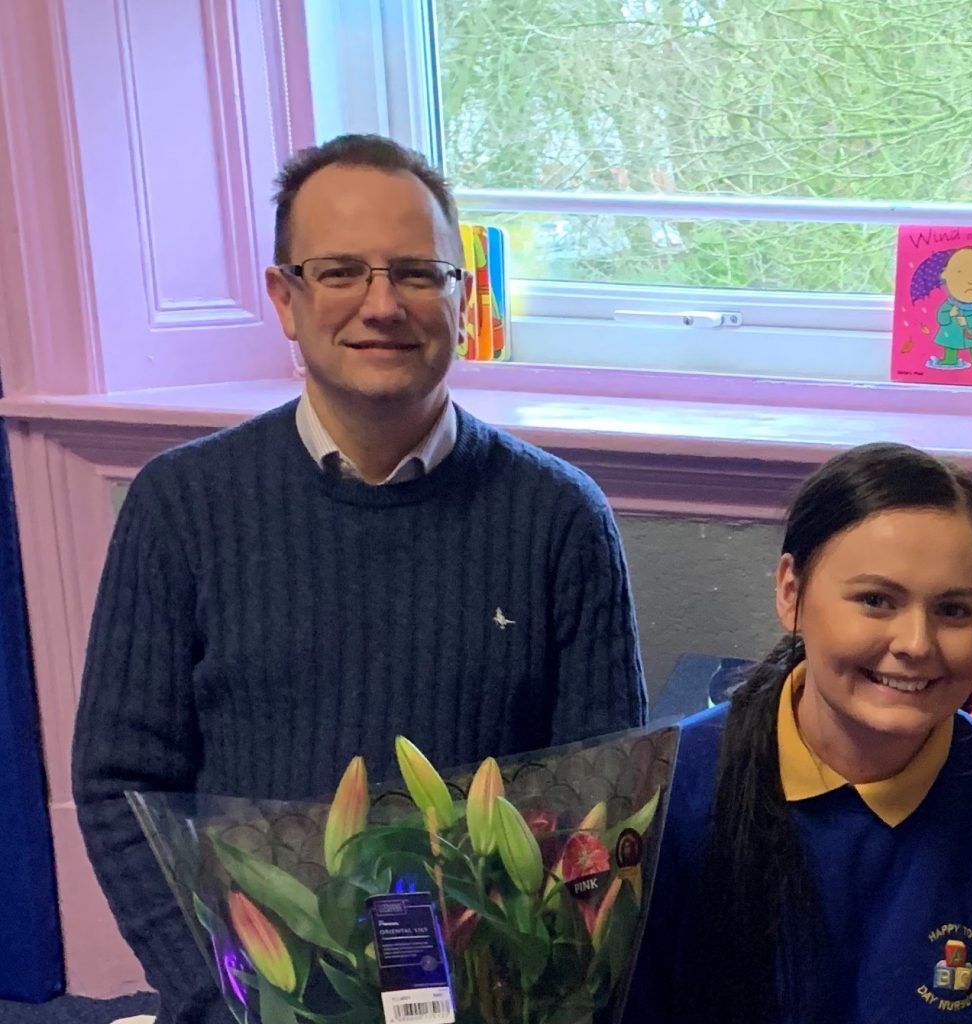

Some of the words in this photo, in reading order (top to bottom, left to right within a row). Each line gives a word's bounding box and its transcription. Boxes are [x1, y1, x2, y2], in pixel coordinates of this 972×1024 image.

[910, 228, 960, 249] Wind
[574, 878, 599, 894] PINK
[928, 923, 960, 941] HAPPY
[917, 984, 939, 1004] DAY
